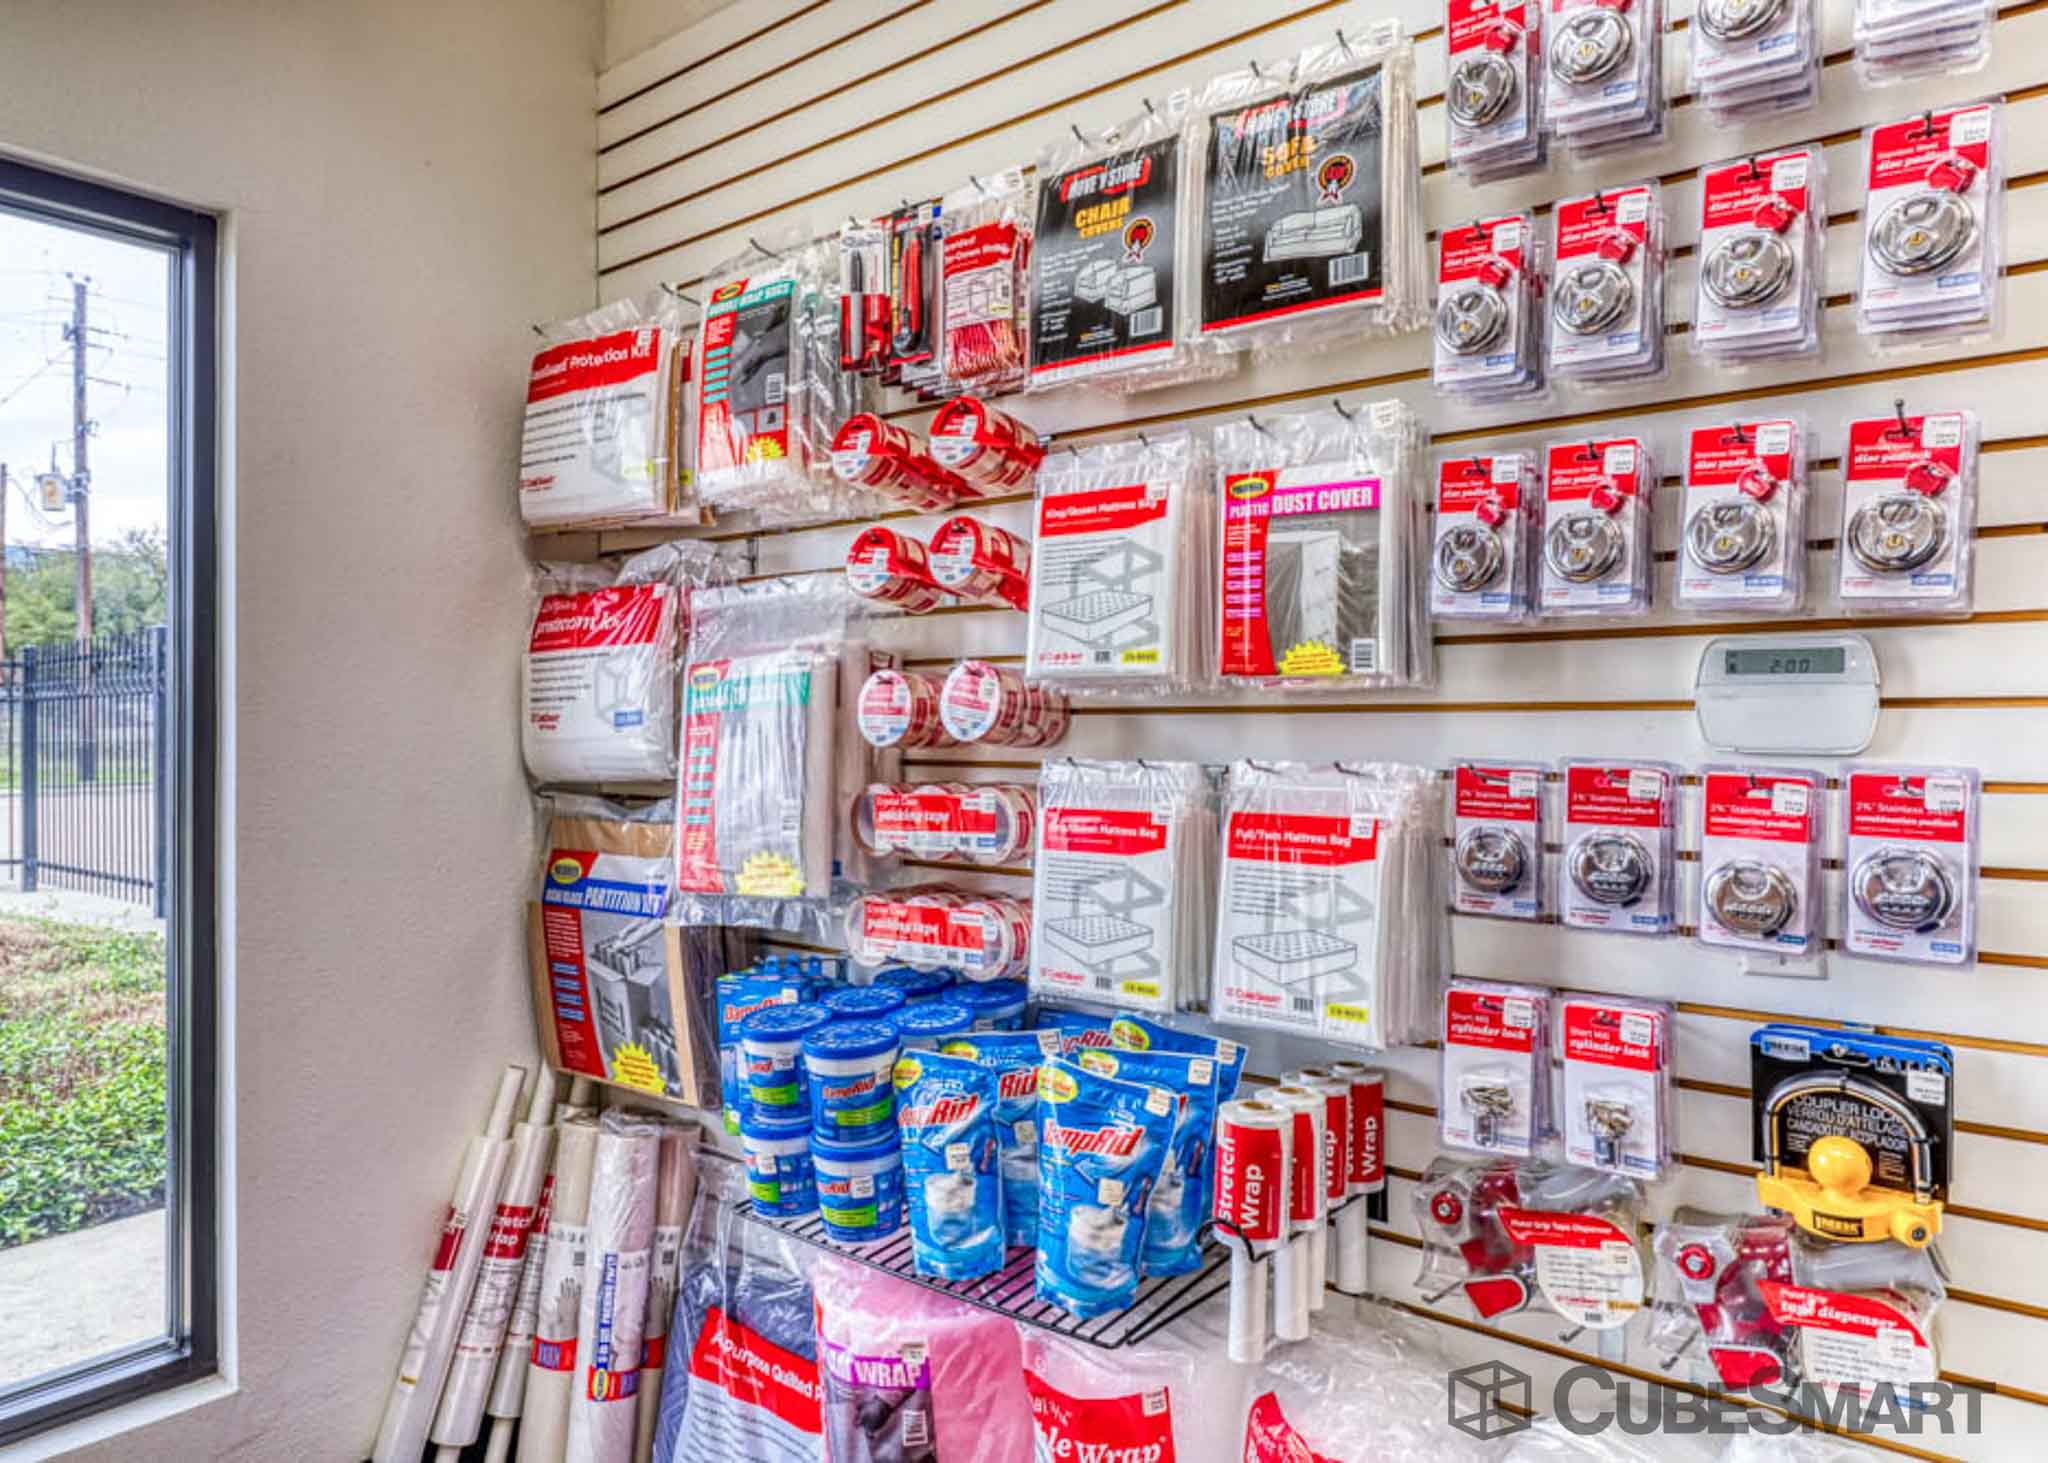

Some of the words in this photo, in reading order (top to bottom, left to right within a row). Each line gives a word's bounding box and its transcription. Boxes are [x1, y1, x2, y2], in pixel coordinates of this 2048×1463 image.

[1075, 195, 1131, 229] CHAIR
[631, 343, 651, 358] Kit
[1138, 498, 1158, 510] Bag
[1272, 492, 1315, 515] DUST
[1318, 486, 1373, 510] COVER
[1139, 827, 1158, 840] Bag
[1284, 831, 1327, 844] Mattress
[1329, 834, 1352, 847] Bag
[1570, 1039, 1622, 1055] cylinder
[1623, 1043, 1650, 1059] lock
[1793, 1095, 1860, 1116] COUPLER
[1361, 1115, 1378, 1177] Wrap
[1217, 1137, 1236, 1222] Stretch
[1240, 1164, 1265, 1230] Wrap
[1817, 1306, 1898, 1329] dispenser
[771, 1363, 814, 1399] Quilted
[856, 1361, 925, 1389] WRAP
